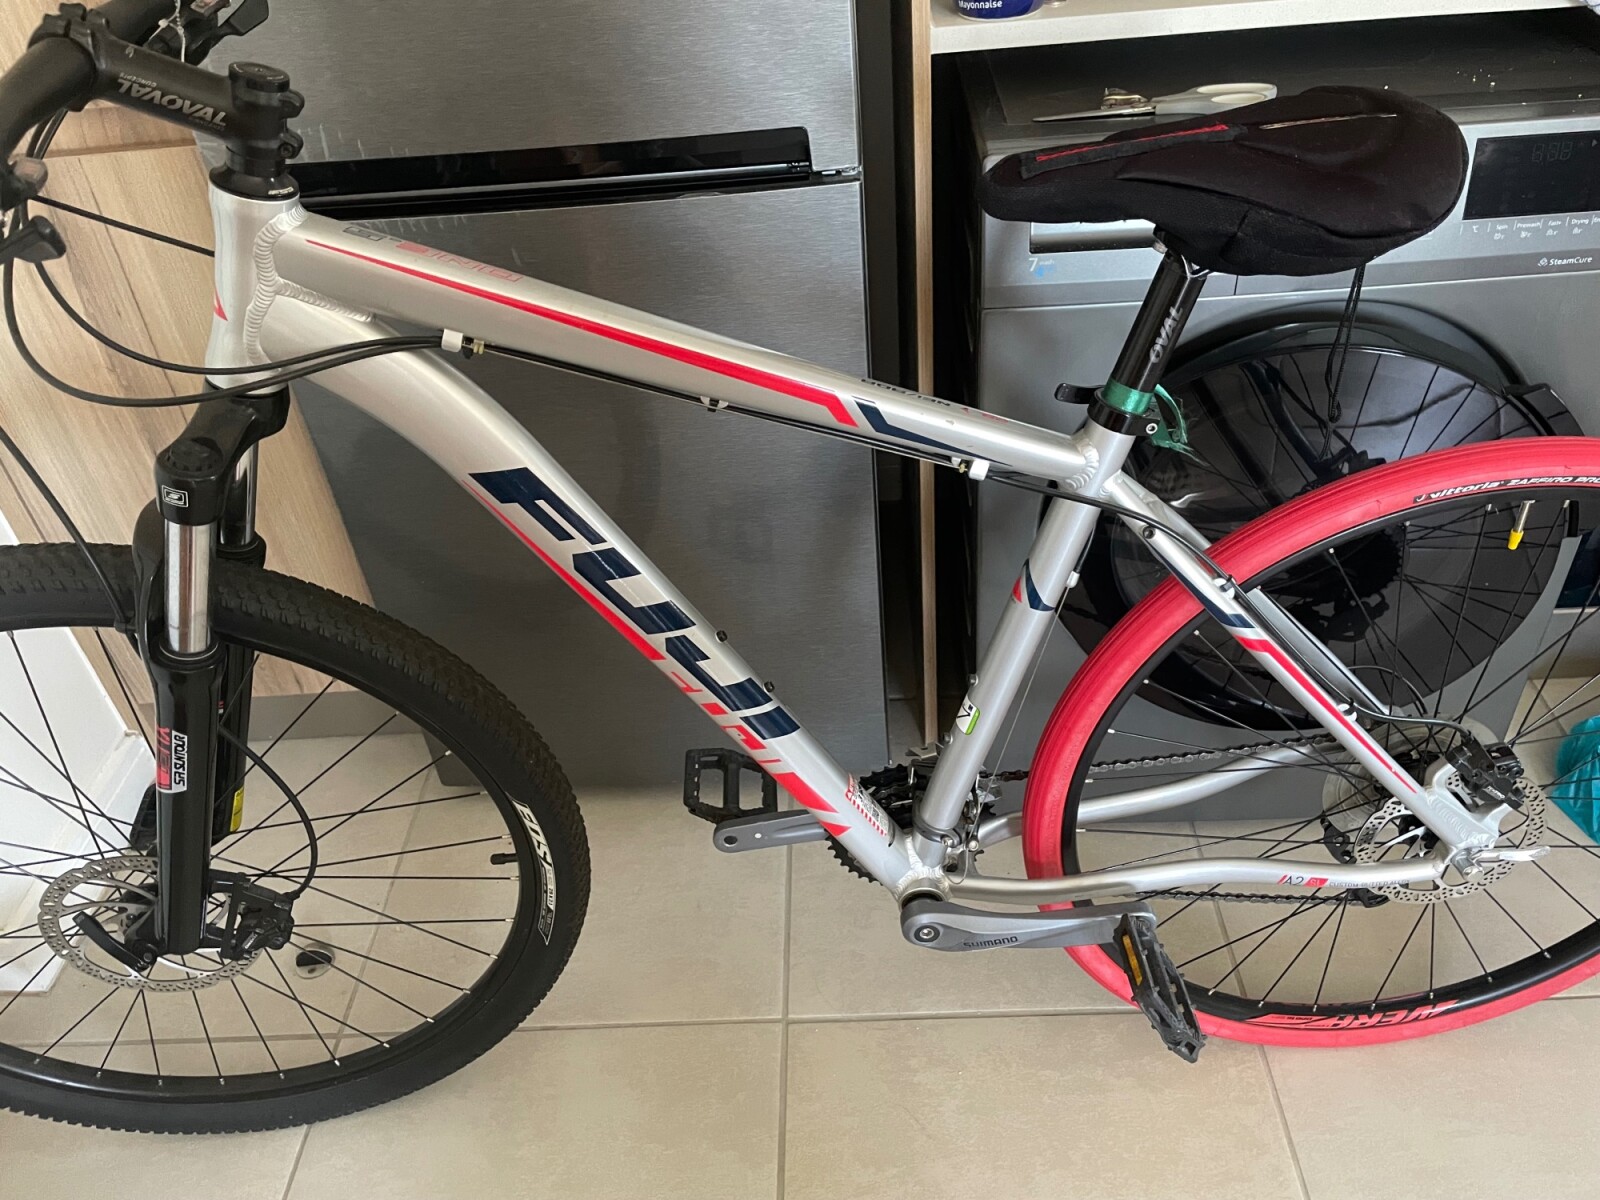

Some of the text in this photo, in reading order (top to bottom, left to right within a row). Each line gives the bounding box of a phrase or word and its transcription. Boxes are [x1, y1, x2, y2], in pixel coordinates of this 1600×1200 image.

[958, 0, 1003, 10] Mayonnaise
[1549, 256, 1593, 266] SteamCure
[1429, 481, 1500, 498] vittoria
[468, 466, 801, 740] FUJI
[173, 734, 187, 772] SUNTOUR
[963, 935, 1019, 948] SHIMANO
